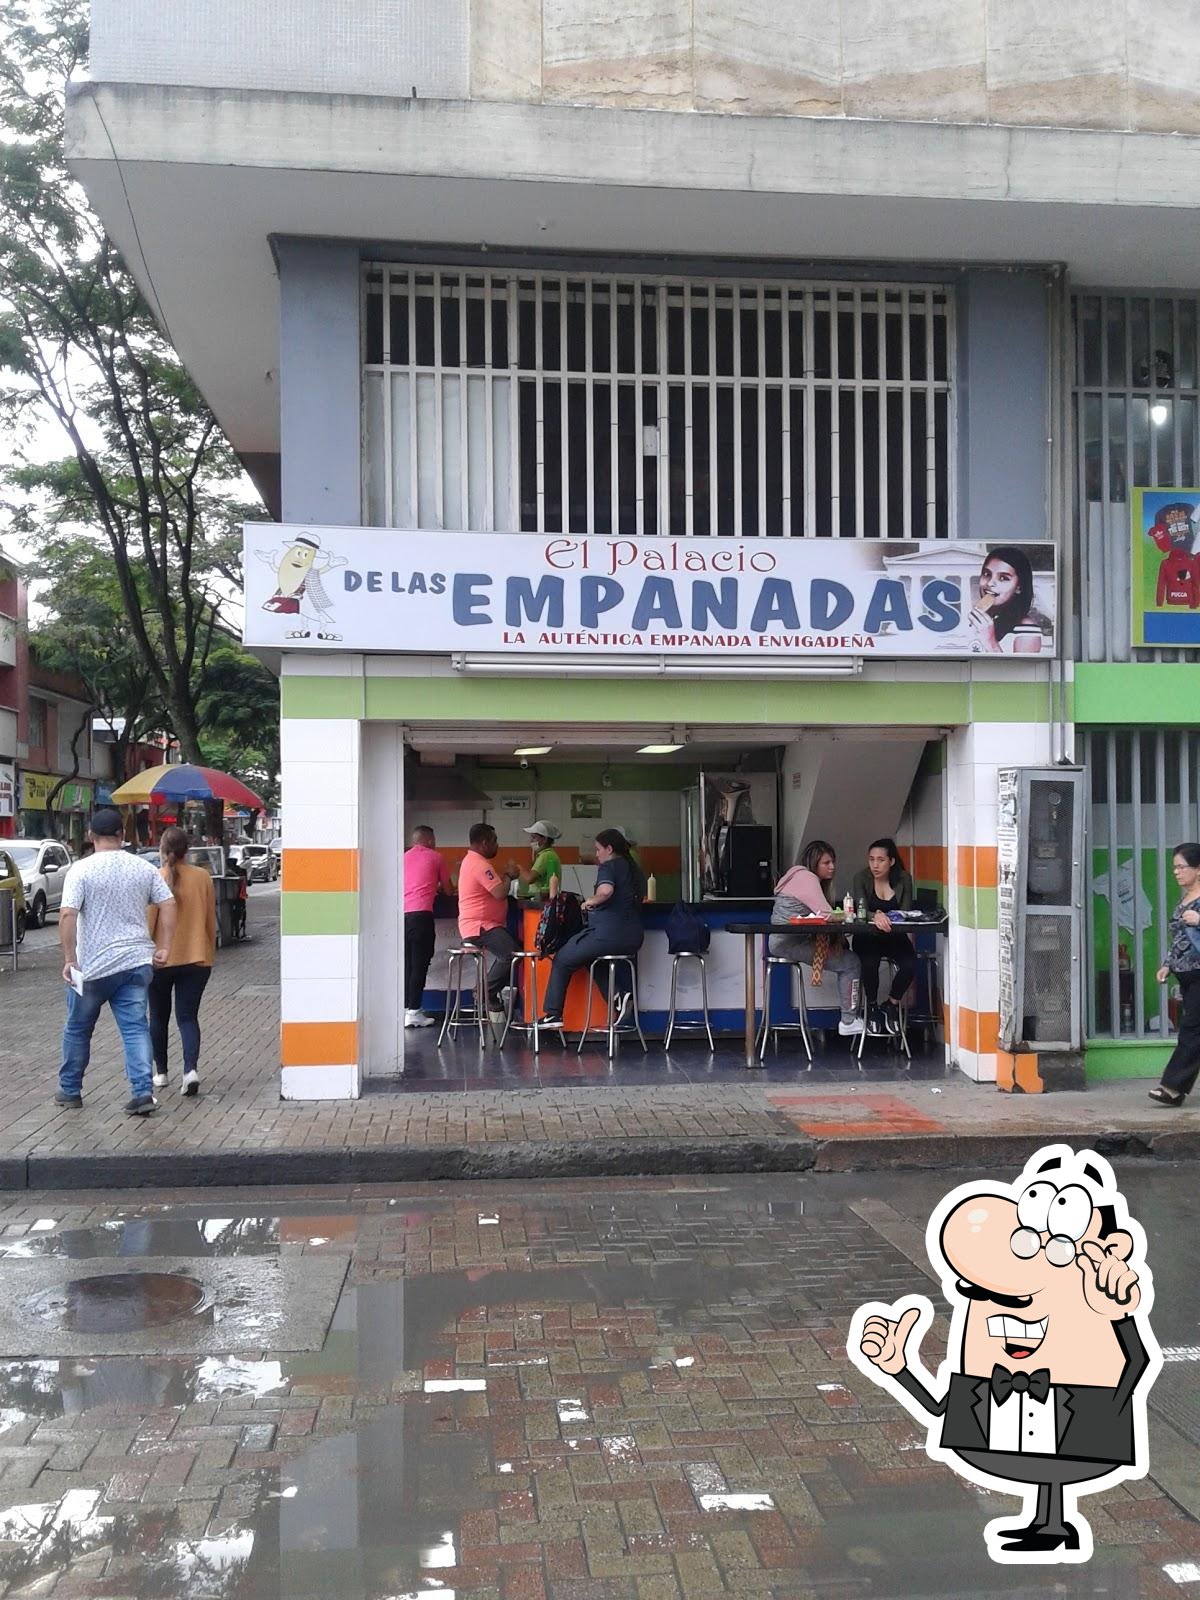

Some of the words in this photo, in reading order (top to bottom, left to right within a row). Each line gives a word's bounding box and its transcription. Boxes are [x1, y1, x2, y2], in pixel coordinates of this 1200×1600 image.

[545, 539, 588, 569] El
[607, 540, 777, 576] Palacio
[344, 570, 383, 593] DE
[392, 572, 446, 594] LAS
[453, 572, 962, 633] EMPANADAS
[503, 631, 526, 645] LA
[538, 630, 644, 646] AUTÉNTICA
[650, 633, 752, 647] EMPANADA
[758, 633, 875, 648] ENVIGADEÑA
